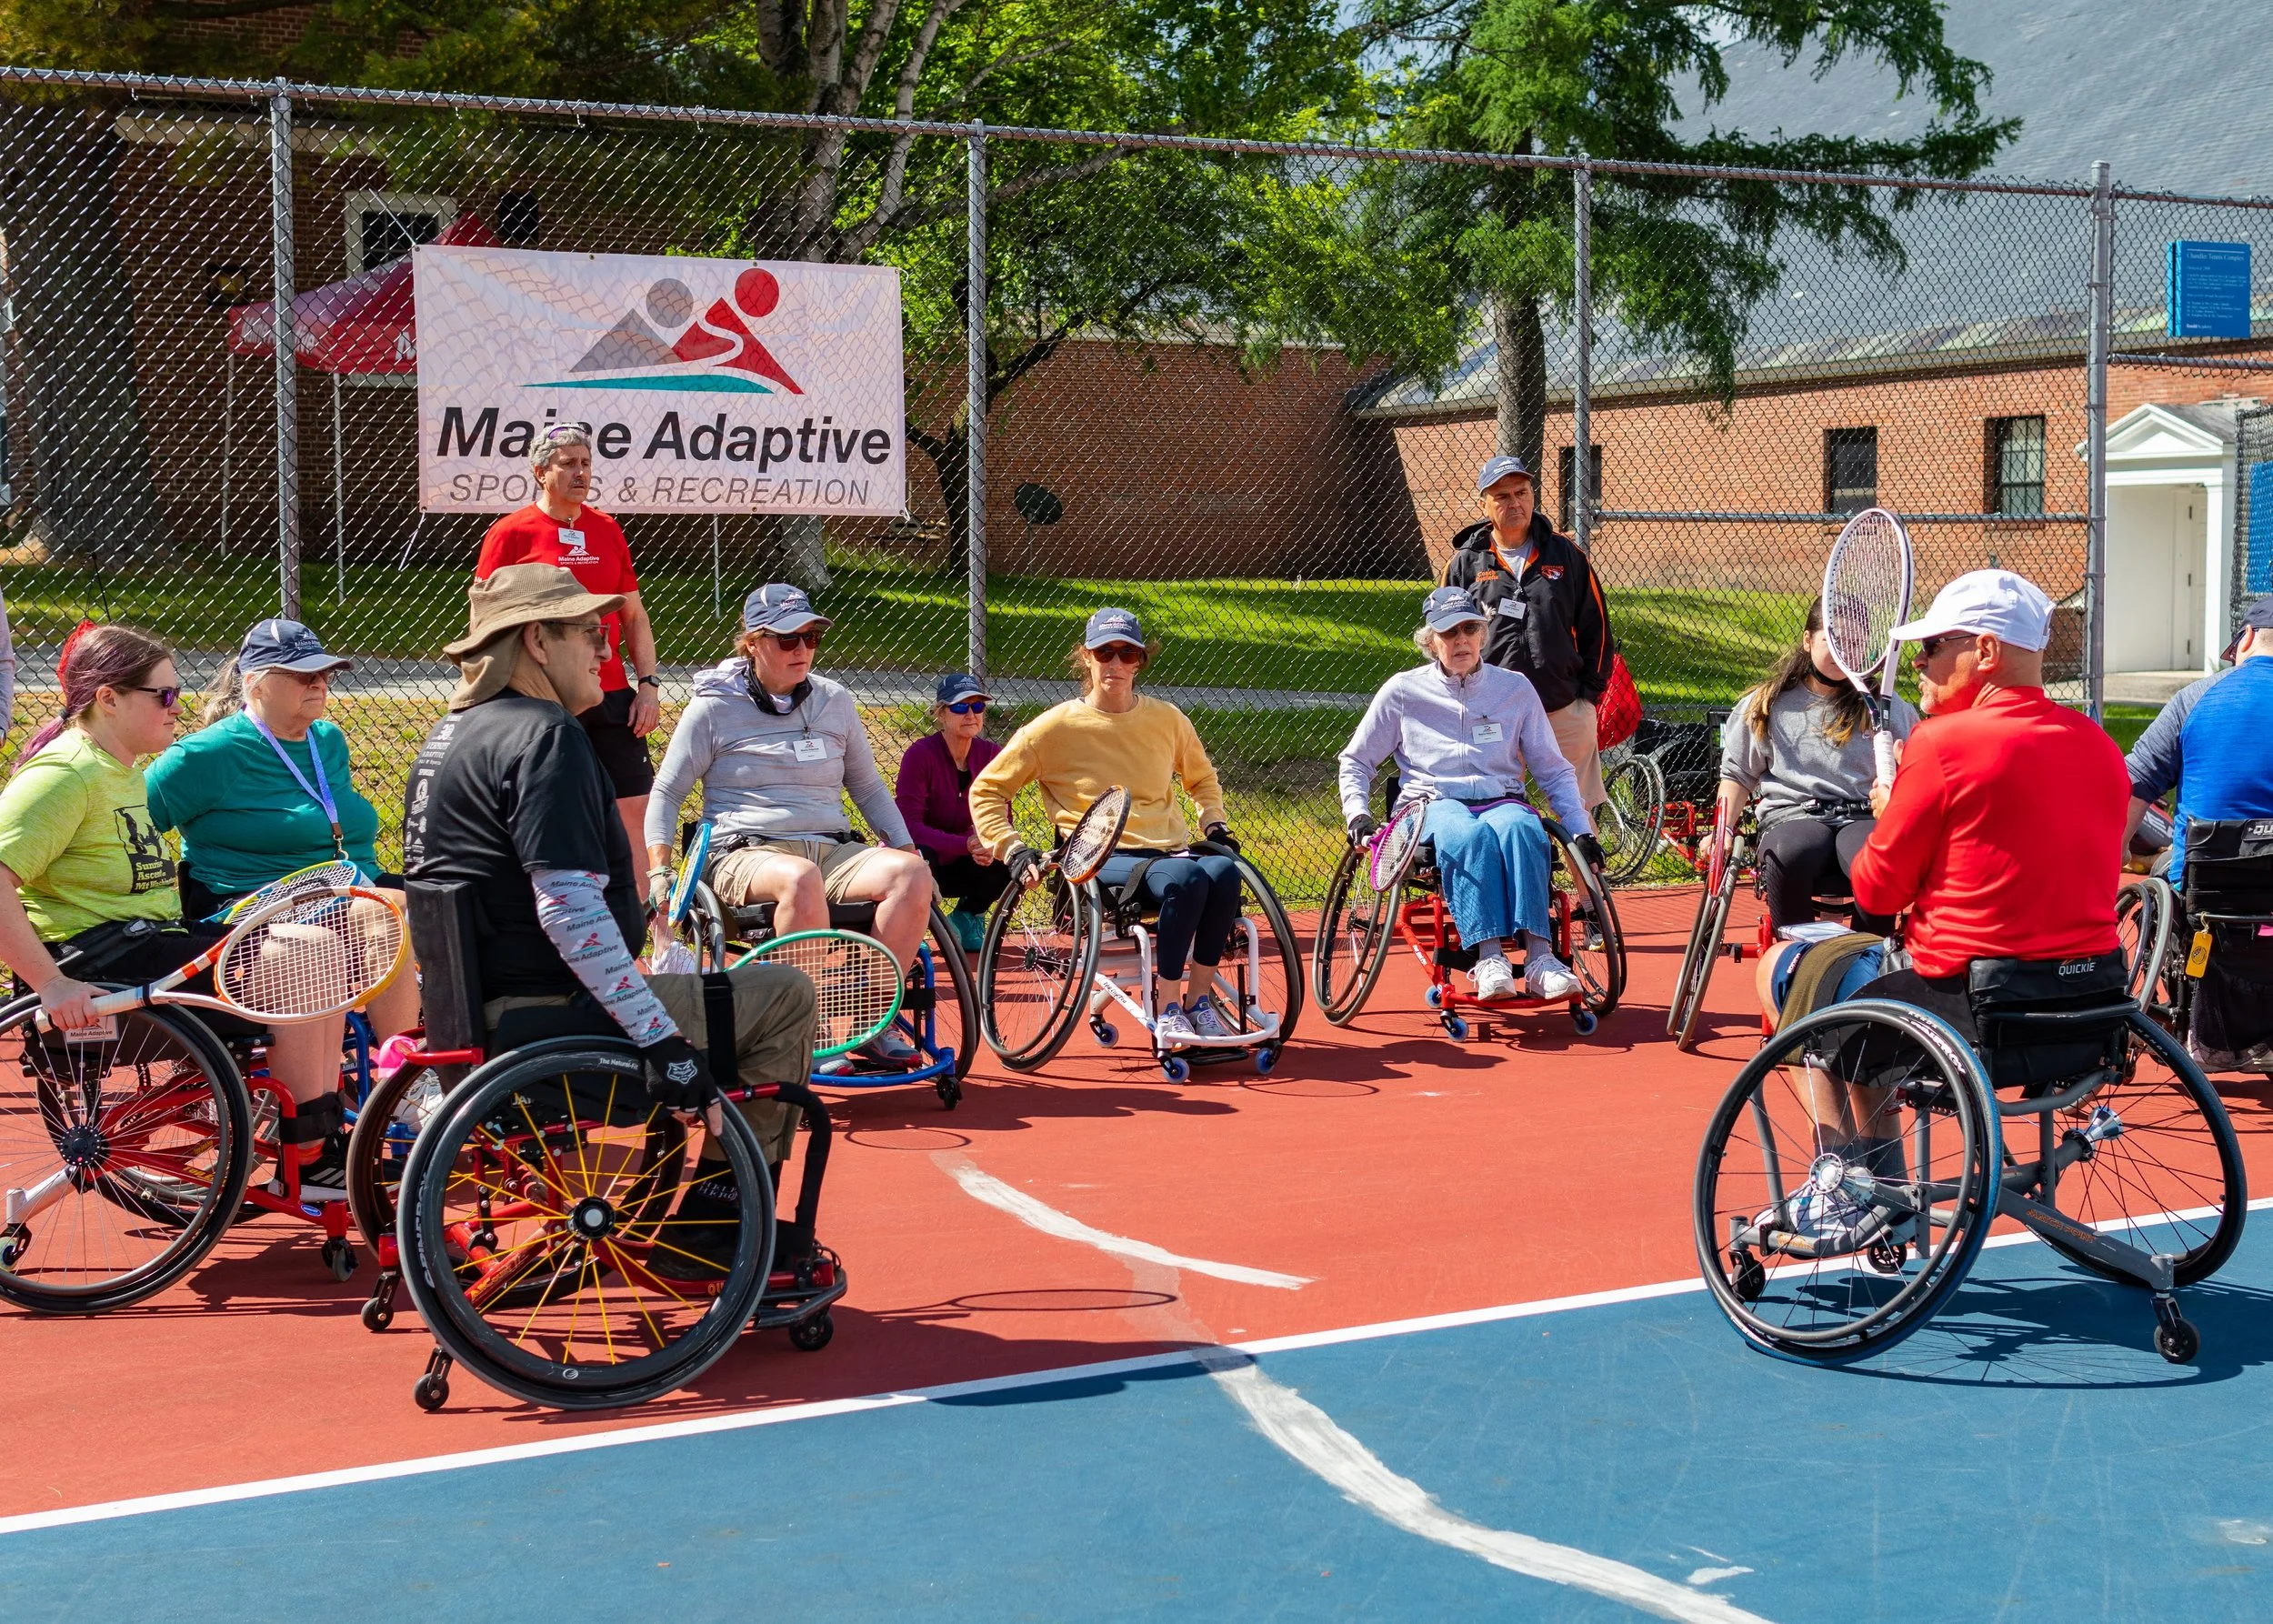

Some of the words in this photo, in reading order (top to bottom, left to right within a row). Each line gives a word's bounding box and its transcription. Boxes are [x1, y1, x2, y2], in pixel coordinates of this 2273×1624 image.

[436, 406, 632, 460] Mae
[642, 411, 891, 474] Adaptive
[450, 474, 604, 502] SPOS
[617, 476, 638, 503] &
[651, 476, 870, 506] RECREATION
[576, 555, 600, 563] Adaptive
[566, 919, 595, 932] Maine
[580, 944, 618, 961] Adaptive
[2058, 961, 2097, 977] QUICKIE
